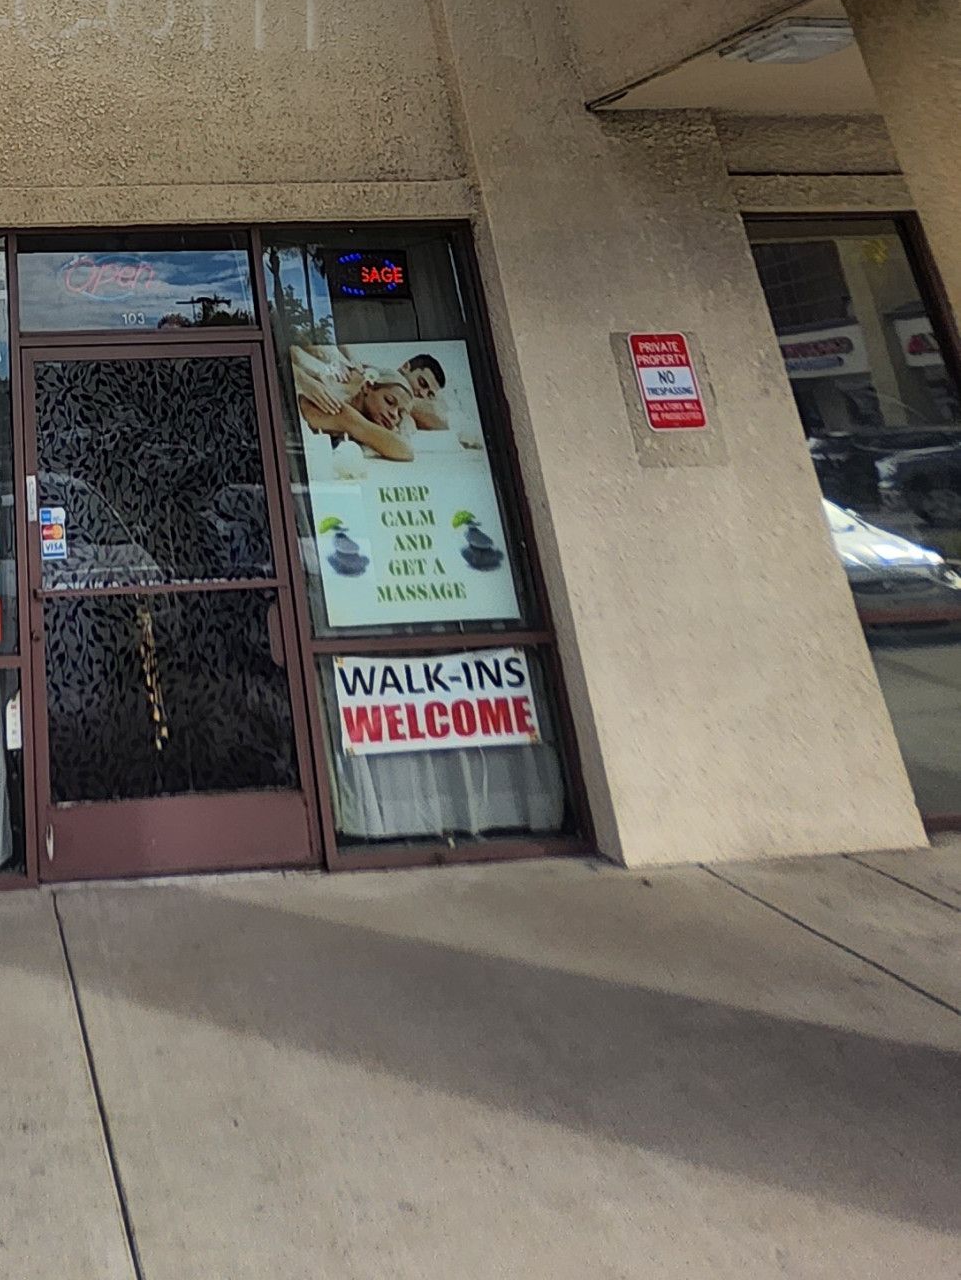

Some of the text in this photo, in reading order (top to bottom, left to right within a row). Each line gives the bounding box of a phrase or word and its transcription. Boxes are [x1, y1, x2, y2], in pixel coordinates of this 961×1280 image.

[65, 260, 156, 294] Open
[361, 266, 404, 283] SAGE
[122, 313, 145, 325] 103
[638, 341, 680, 353] PRIVATE
[636, 353, 687, 366] PROPERTY
[657, 370, 676, 385] NO
[379, 486, 430, 503] KEEP
[381, 509, 436, 528] CALM
[45, 543, 64, 552] VISA
[394, 533, 433, 551] AND
[388, 557, 446, 576] GET A
[377, 582, 467, 602] MASSAGE
[338, 657, 525, 696] WALK-INS
[342, 696, 536, 744] WELCOME
